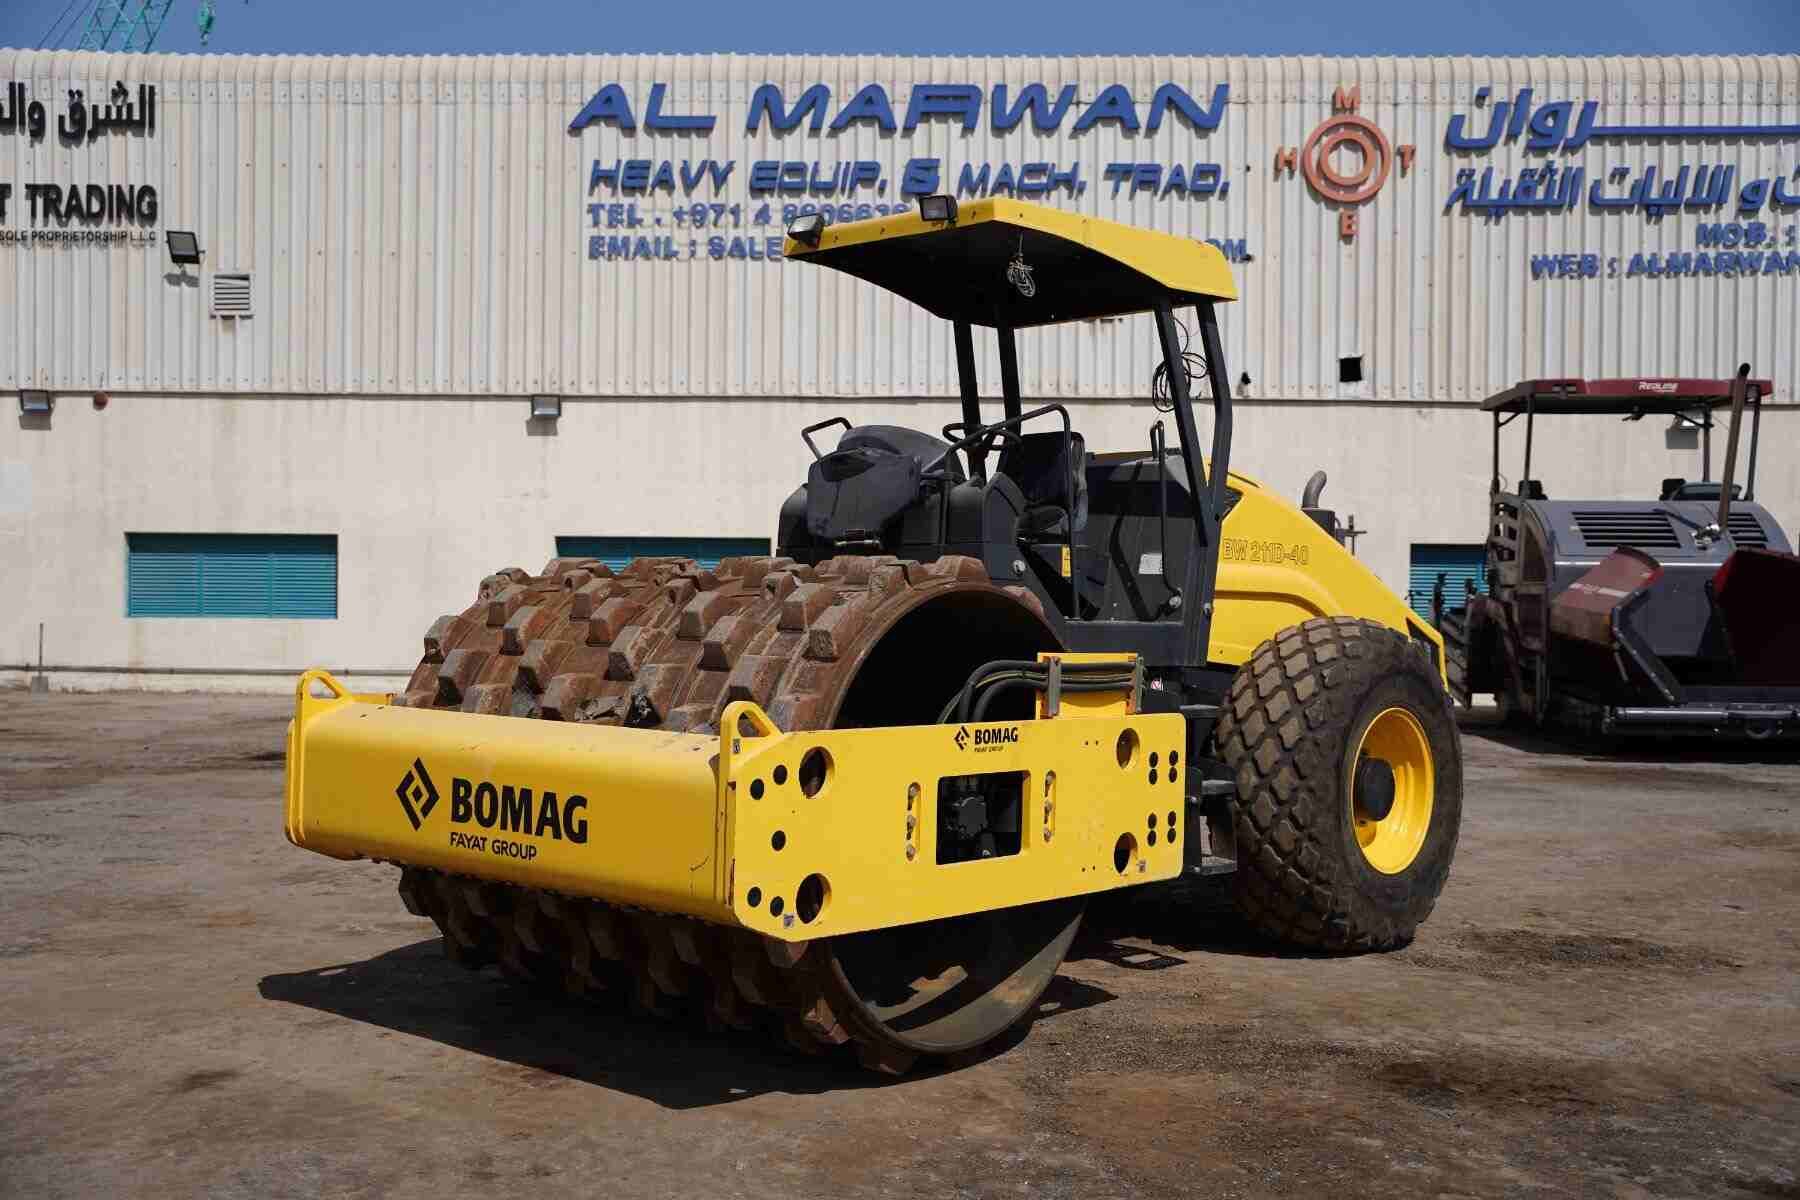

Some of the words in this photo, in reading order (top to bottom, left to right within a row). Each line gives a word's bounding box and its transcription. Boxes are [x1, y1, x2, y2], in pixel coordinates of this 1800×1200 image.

[58, 81, 156, 142] الشرق
[568, 83, 716, 130] AL
[746, 83, 1229, 130] MARWAN
[590, 160, 735, 192] HEAVY
[25, 184, 158, 218] TRADING
[673, 203, 741, 226] +971
[753, 203, 772, 226] 4
[31, 231, 128, 242] PROPRIETORSHIP
[589, 236, 680, 259] EMAIL
[708, 236, 783, 259] SALE
[1531, 254, 1599, 276] WEB
[975, 727, 1019, 745] BOMAG
[451, 777, 588, 844] BOMAG
[450, 832, 487, 852] FAYAT
[492, 839, 537, 861] GROUP
